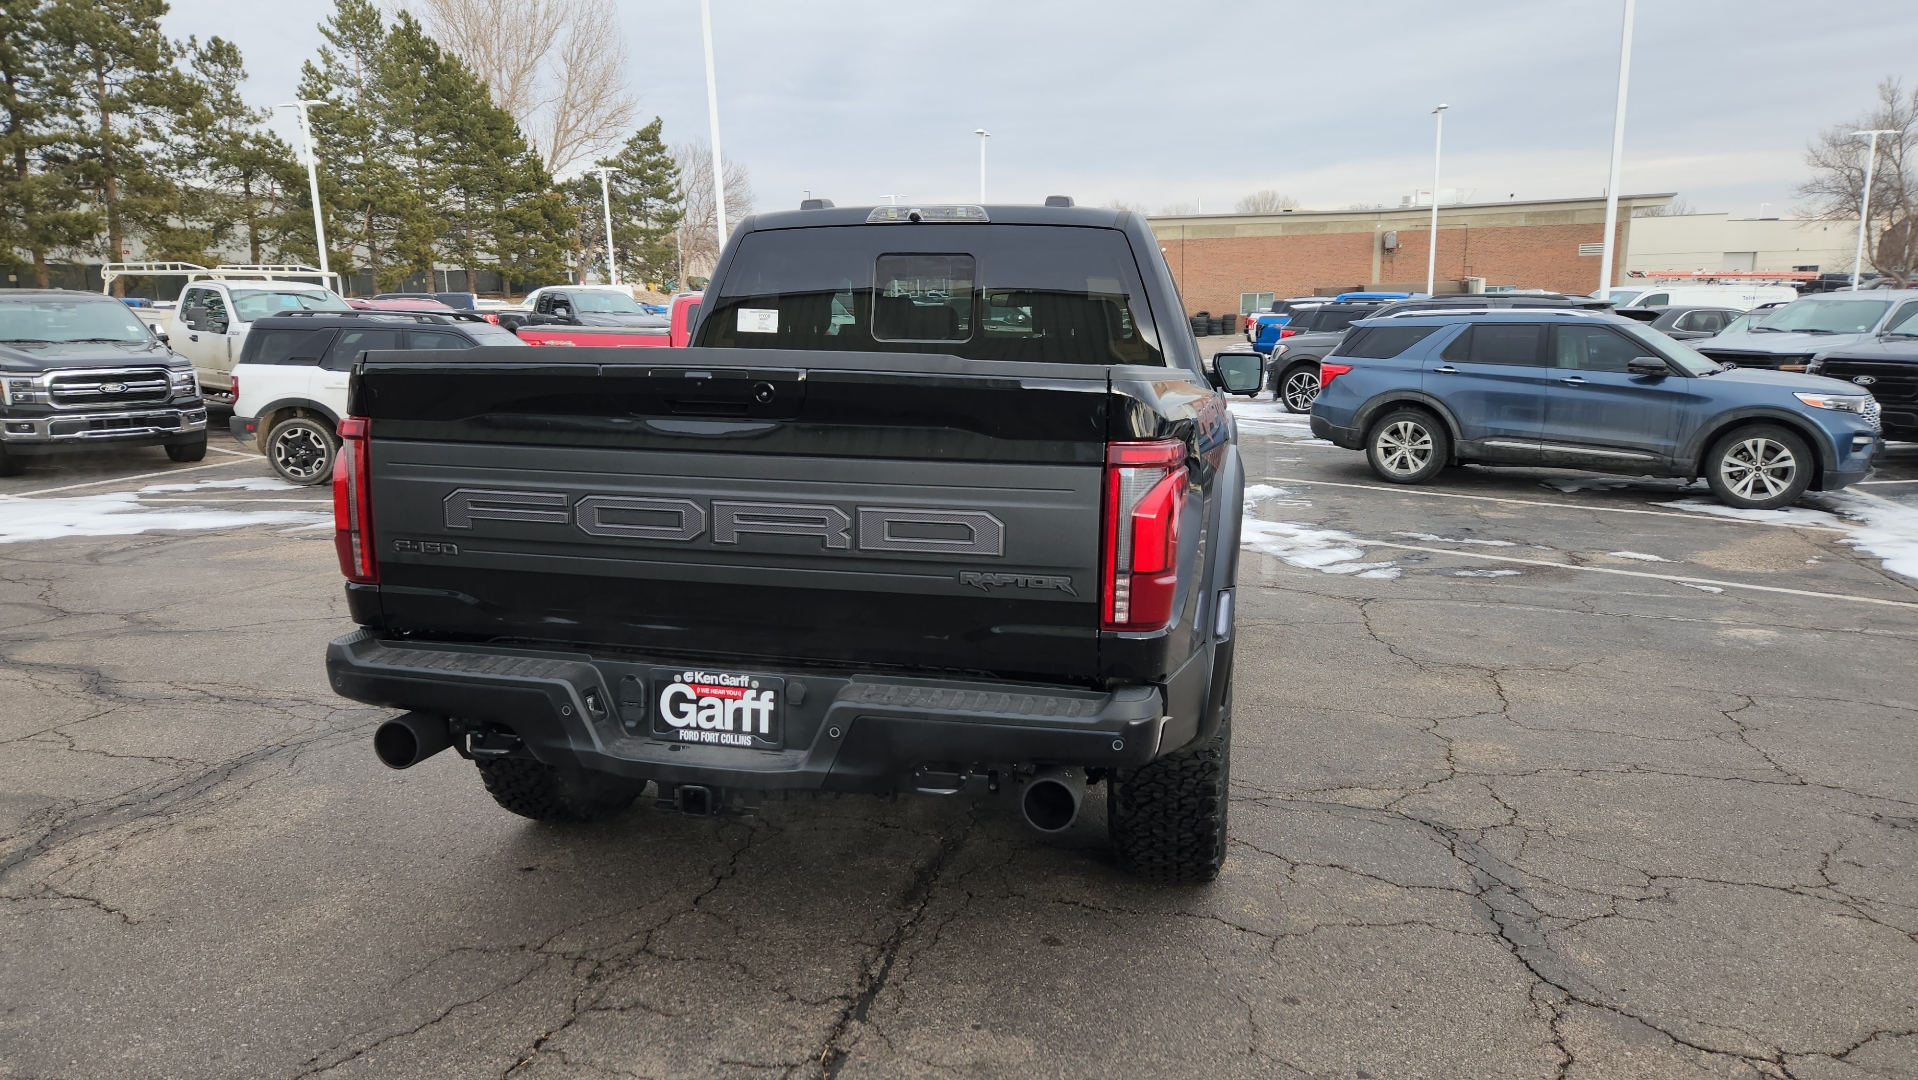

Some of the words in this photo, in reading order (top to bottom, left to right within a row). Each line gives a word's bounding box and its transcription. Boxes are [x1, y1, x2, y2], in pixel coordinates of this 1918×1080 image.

[443, 487, 1005, 557] FORD
[393, 540, 458, 556] F-150
[959, 571, 1079, 597] RAPTOR
[694, 671, 719, 685] Ken
[719, 673, 750, 687] Garff
[660, 683, 774, 733] Garff
[679, 730, 699, 741] FORD
[700, 731, 720, 743] FORT
[720, 733, 752, 746] COLLINS
